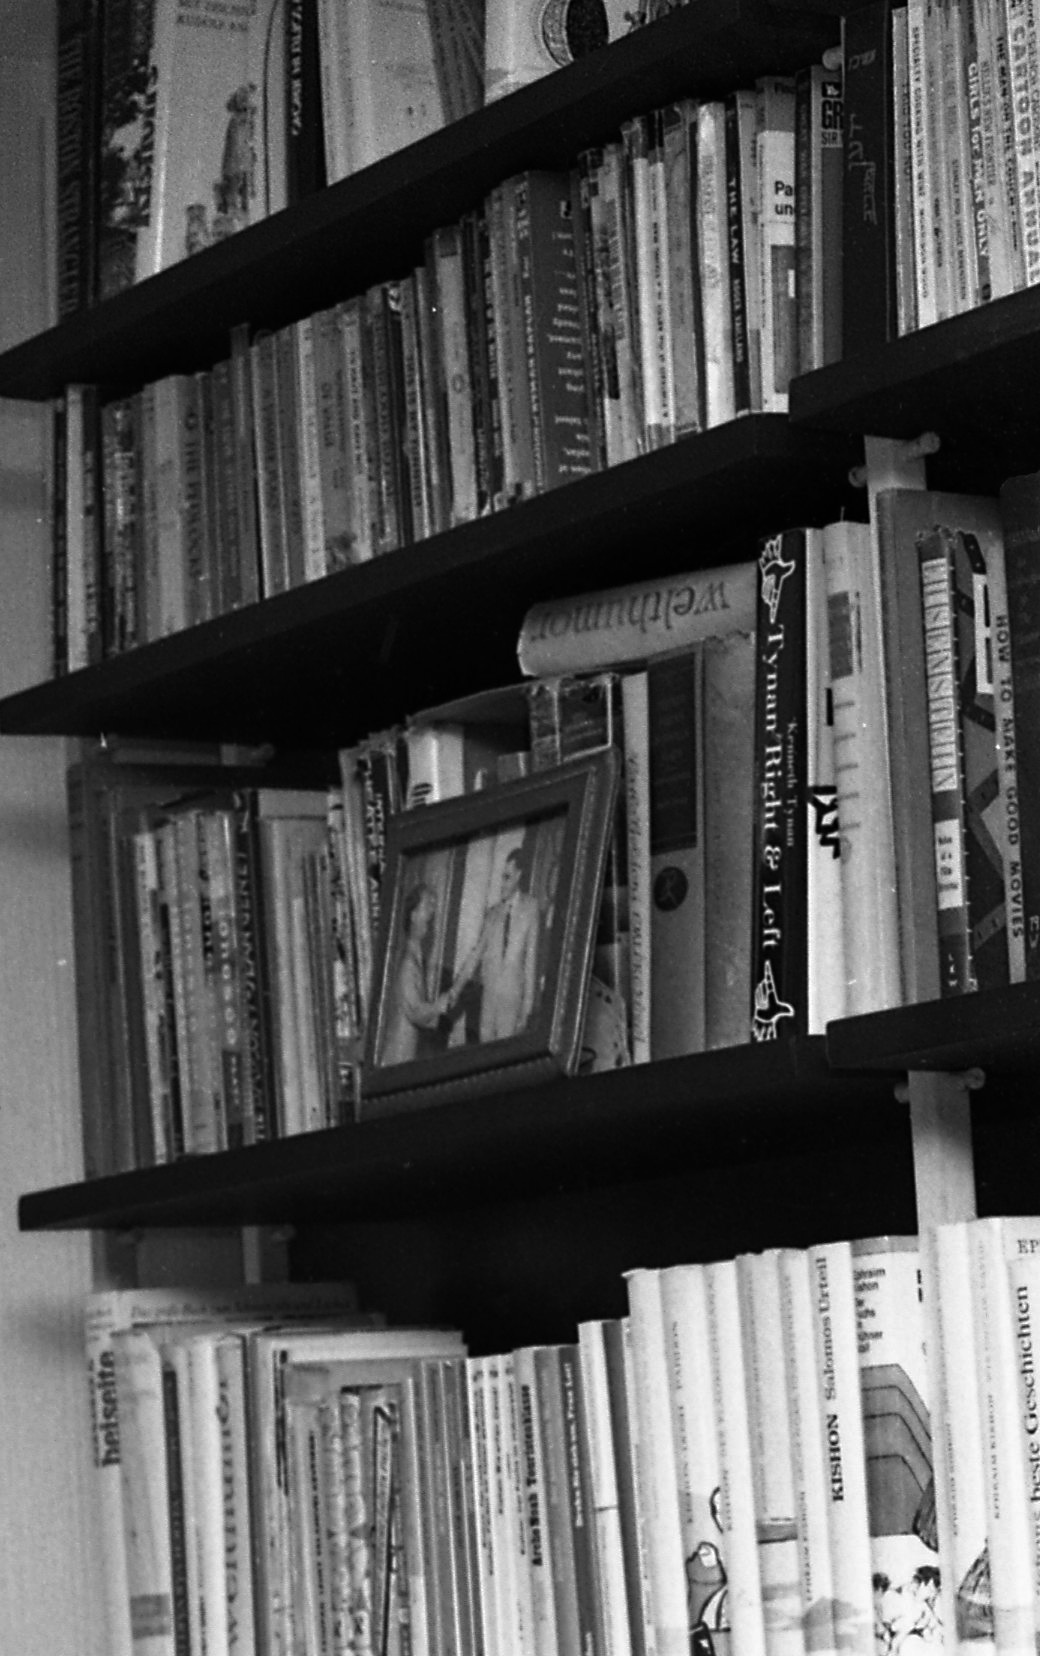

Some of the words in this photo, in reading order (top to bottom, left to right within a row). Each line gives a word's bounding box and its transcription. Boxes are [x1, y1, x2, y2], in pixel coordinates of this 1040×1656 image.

[912, 26, 922, 84] SPECIALTY
[914, 87, 924, 136] COOKING
[968, 62, 981, 121] GIRLS
[1013, 26, 1032, 156] CARTOON
[971, 126, 983, 153] for
[728, 177, 737, 216] THE
[774, 179, 795, 197] Pa
[774, 203, 795, 217] un
[731, 224, 739, 264] LAW
[977, 209, 989, 257] ONLY
[1021, 171, 1040, 289] ANNUAL
[530, 580, 732, 642] welthumor
[995, 614, 1010, 663] HOW
[762, 624, 785, 734] Tynan
[1000, 678, 1014, 703] TO
[786, 717, 798, 789] Kenneth
[1002, 717, 1017, 773] MAKE
[760, 736, 785, 831] Right
[784, 793, 798, 848] Tynan
[1006, 786, 1020, 845] GOOD
[763, 844, 782, 872] &
[762, 881, 784, 951] Left
[1009, 860, 1025, 939] MOVIES
[854, 1268, 886, 1281] phraim
[1017, 1239, 1040, 1253] EP
[817, 1256, 831, 1313] Urteil
[822, 1317, 837, 1401] Salomos
[1015, 1284, 1040, 1435] Geschichten
[521, 1384, 537, 1488] Touristenklasse
[987, 1394, 997, 1450] KISHON
[828, 1413, 845, 1503] KISHON
[990, 1454, 1001, 1520] EPHRAIM
[530, 1529, 543, 1567] Arche
